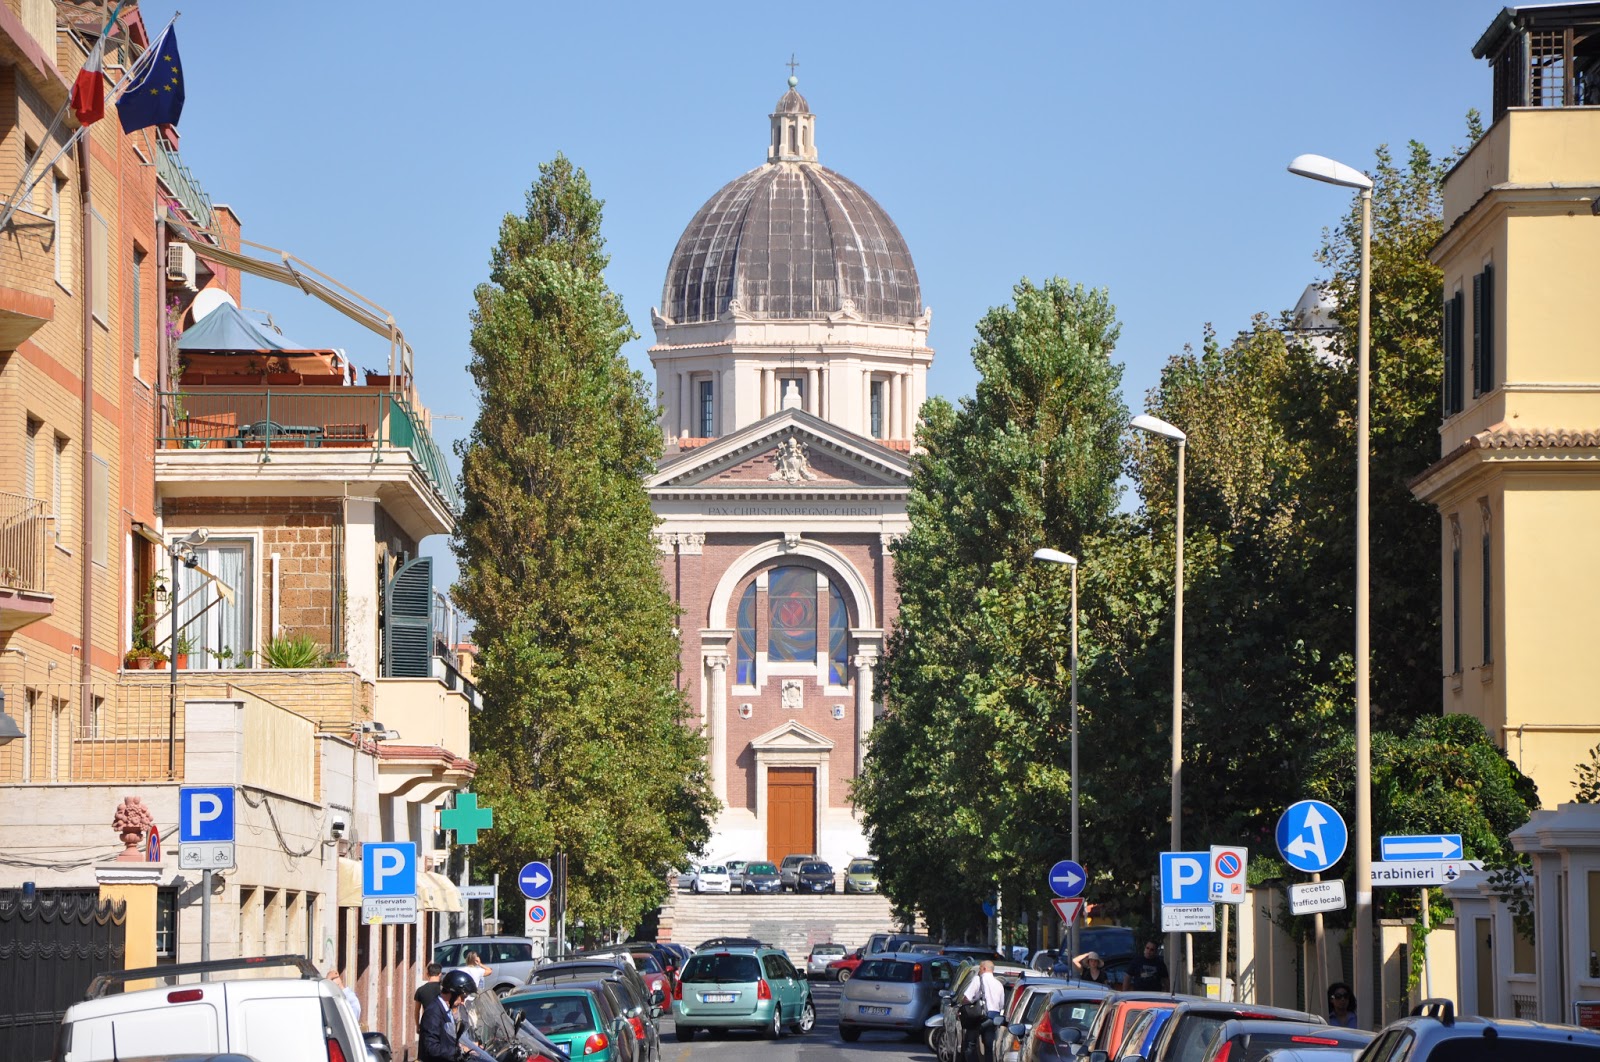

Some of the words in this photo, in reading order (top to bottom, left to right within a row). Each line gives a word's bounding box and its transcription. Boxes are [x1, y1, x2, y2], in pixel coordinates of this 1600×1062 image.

[708, 507, 729, 515] PAX
[191, 793, 223, 836] P
[373, 848, 406, 891] P
[1371, 867, 1434, 880] arabinieri
[1171, 857, 1203, 899] P
[1215, 884, 1222, 892] P
[1301, 885, 1331, 893] eccetto
[1293, 899, 1318, 907] traffico
[1320, 896, 1342, 904] locale
